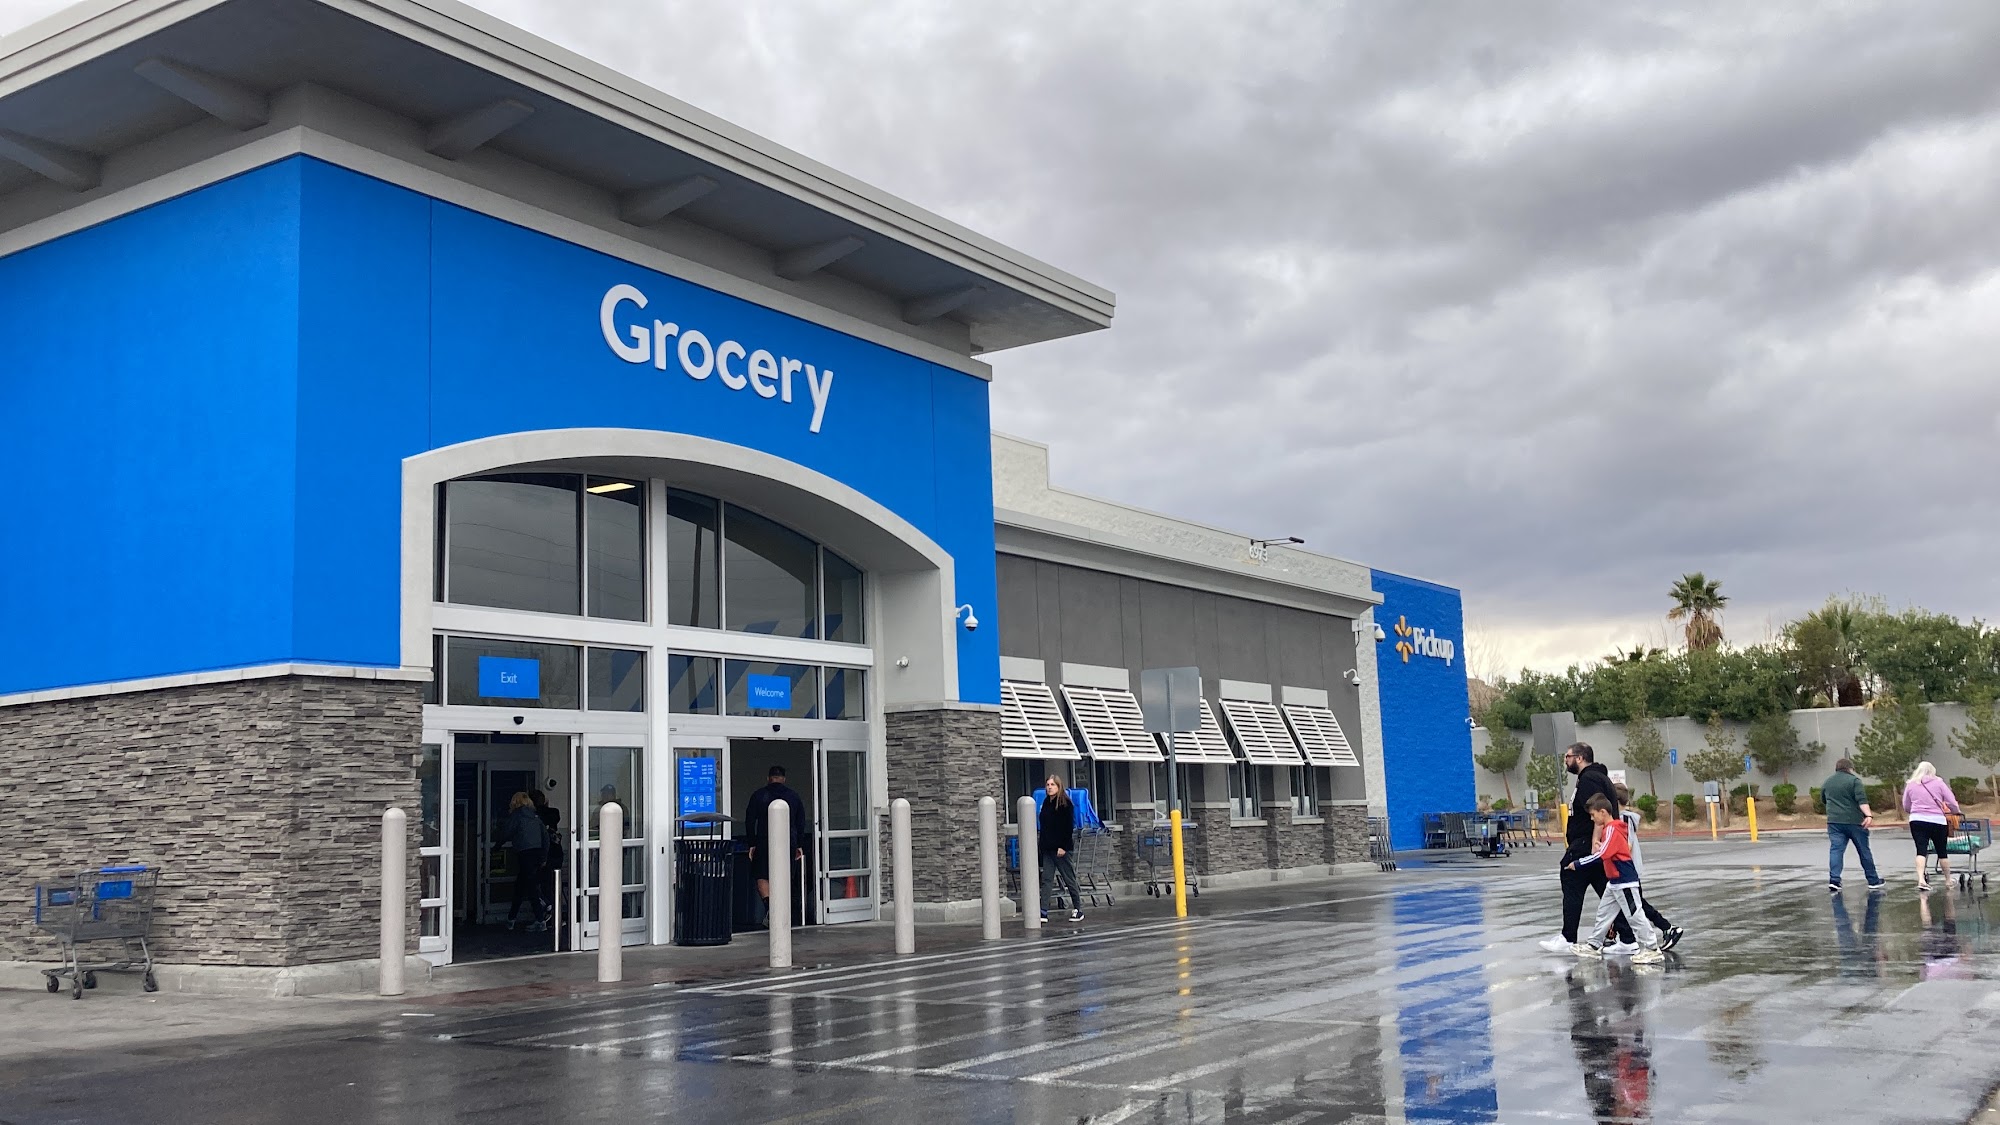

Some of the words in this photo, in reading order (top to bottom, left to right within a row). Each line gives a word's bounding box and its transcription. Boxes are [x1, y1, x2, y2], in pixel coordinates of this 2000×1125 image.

[600, 284, 834, 433] Grocery
[1412, 627, 1454, 667] Pickup
[501, 671, 518, 684] Exit
[754, 686, 785, 698] Welcome
